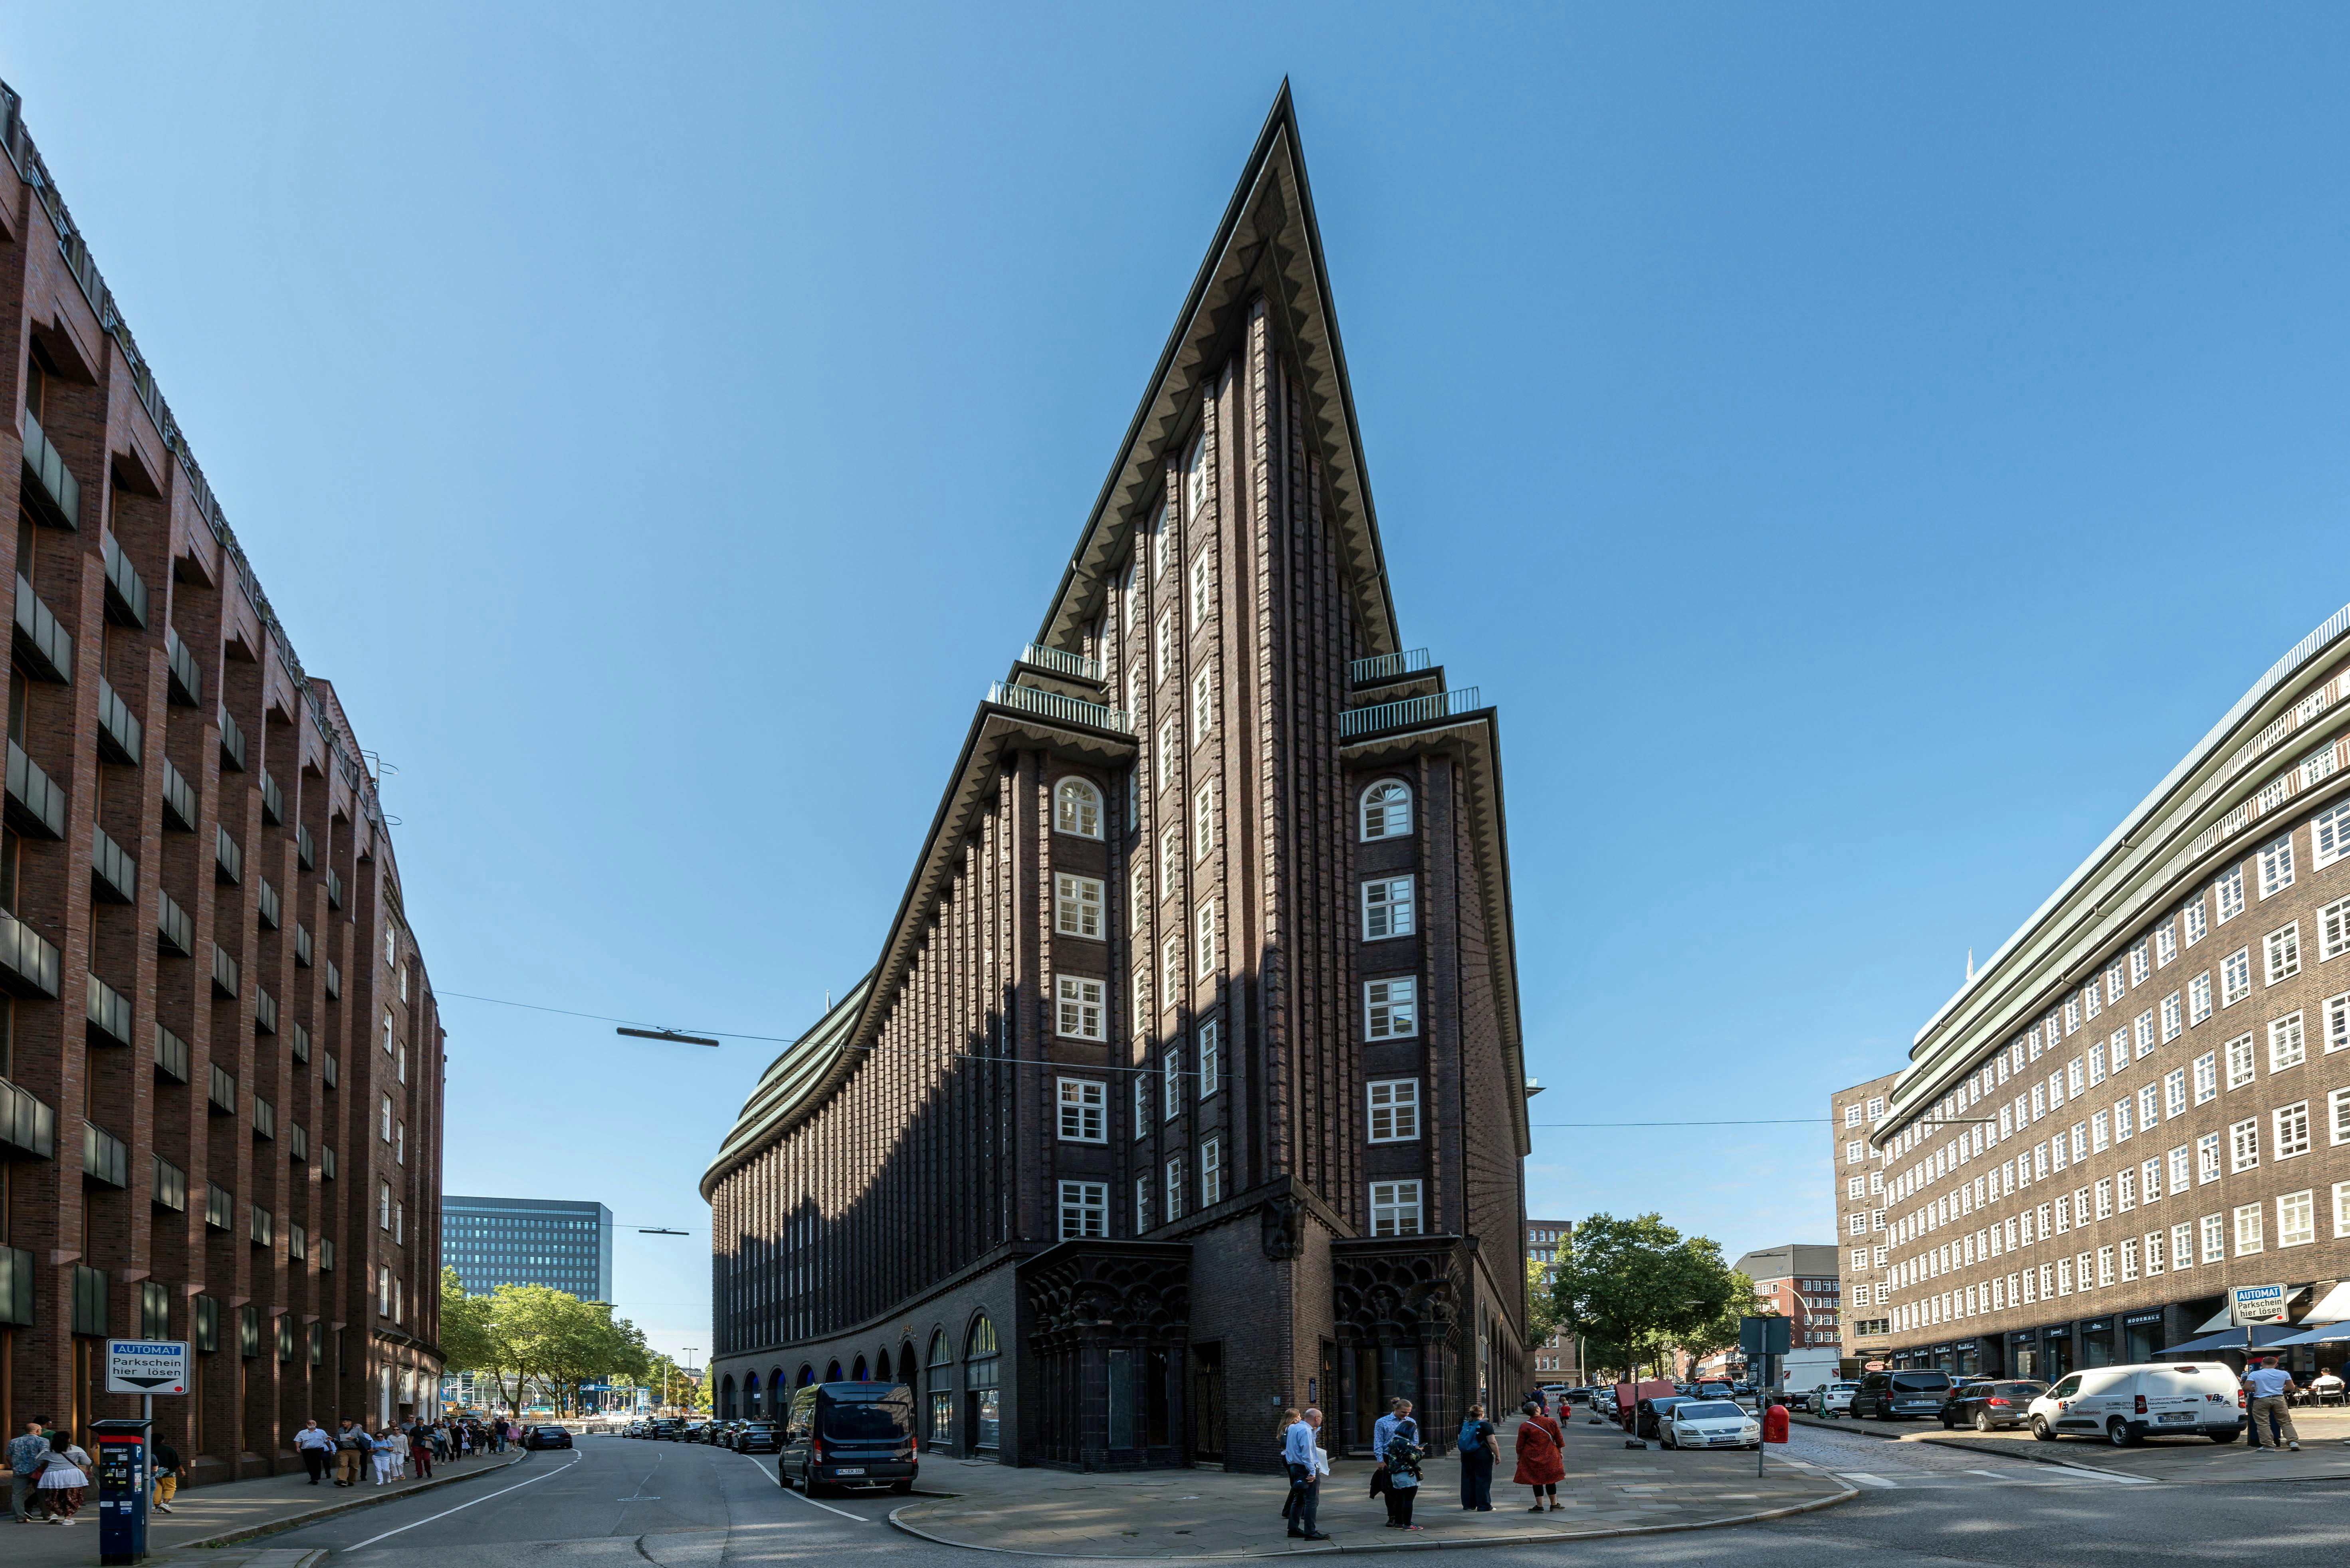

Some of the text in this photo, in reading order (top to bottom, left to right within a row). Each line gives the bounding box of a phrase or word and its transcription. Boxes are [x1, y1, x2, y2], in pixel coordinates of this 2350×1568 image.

[2239, 1288, 2279, 1300] AUTOMAT
[2238, 1299, 2282, 1309] Parkschein
[118, 1345, 177, 1354] AUTOMAT
[113, 1358, 181, 1367] Parkschein
[136, 1446, 141, 1457] P
